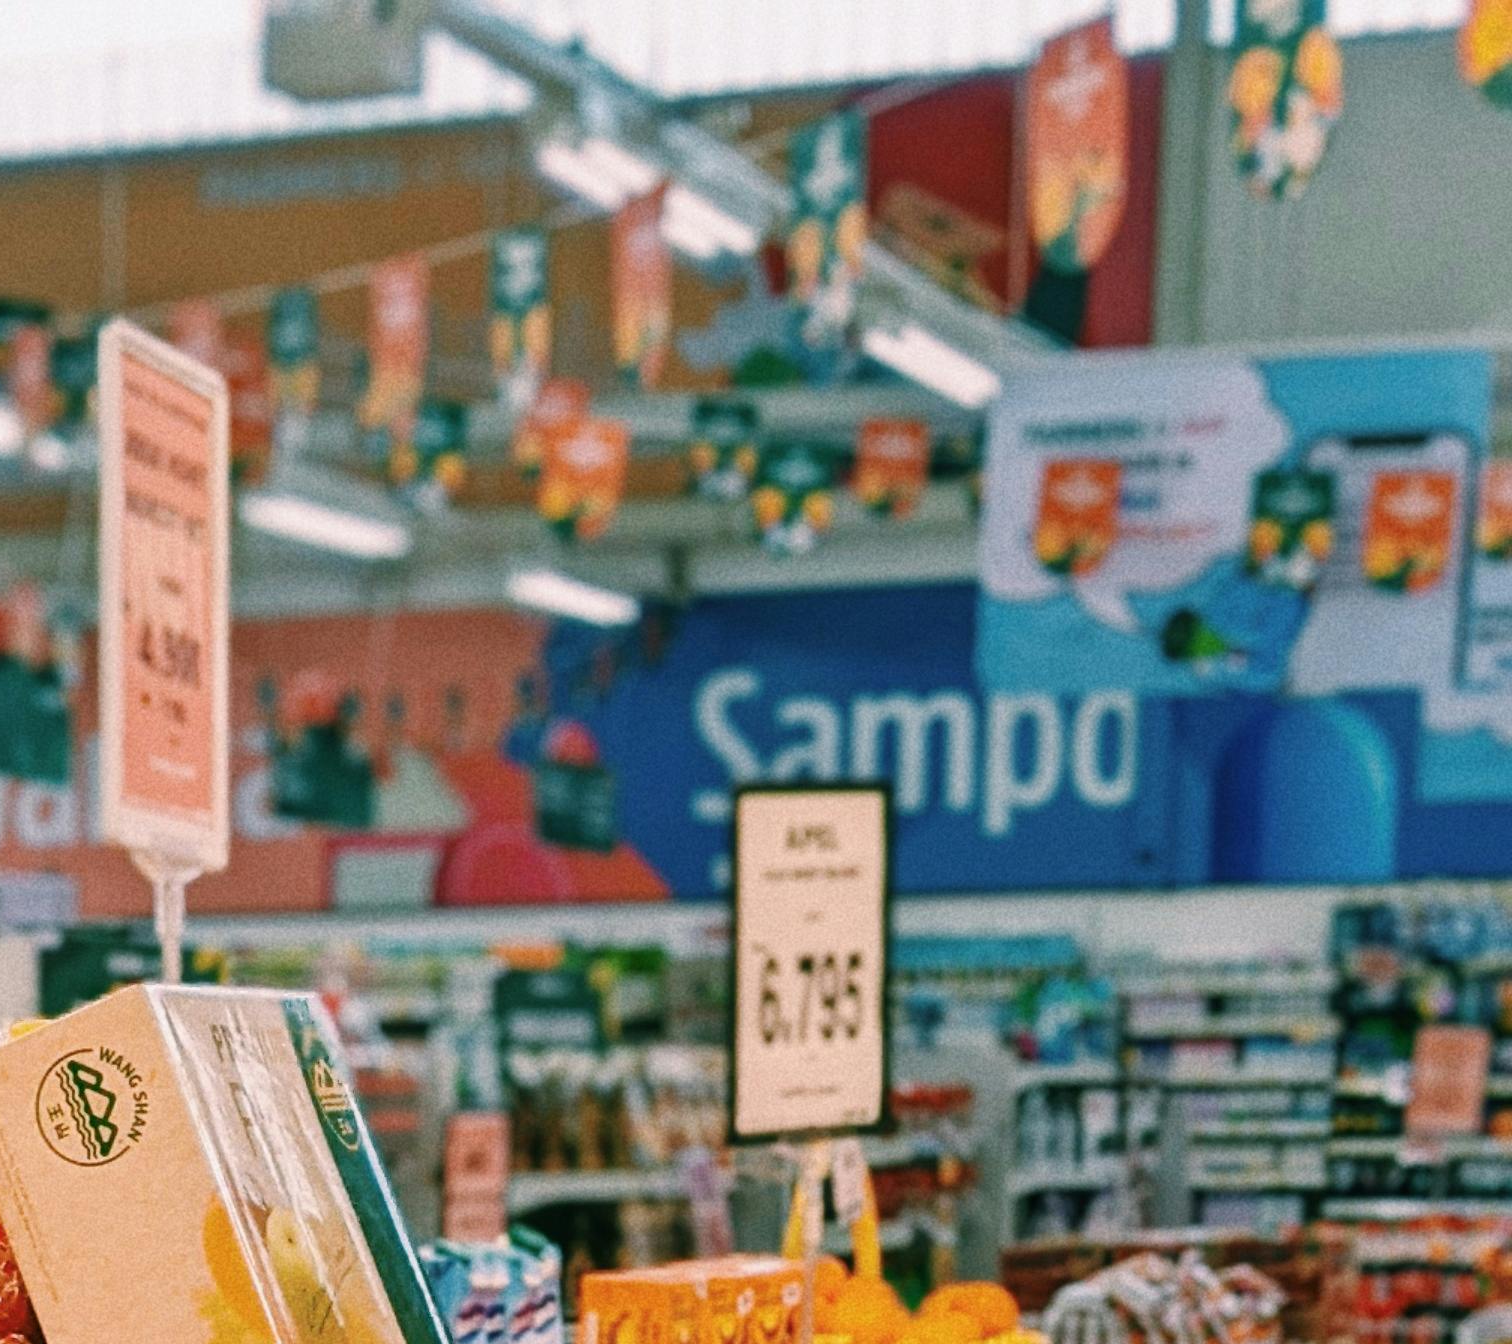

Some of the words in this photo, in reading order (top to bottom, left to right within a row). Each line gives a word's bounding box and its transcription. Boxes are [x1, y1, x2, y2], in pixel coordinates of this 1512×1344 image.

[694, 667, 1138, 836] Sampo
[757, 953, 863, 1044] 6.795
[99, 1046, 143, 1088] WANG
[127, 1091, 148, 1143] SHAN
